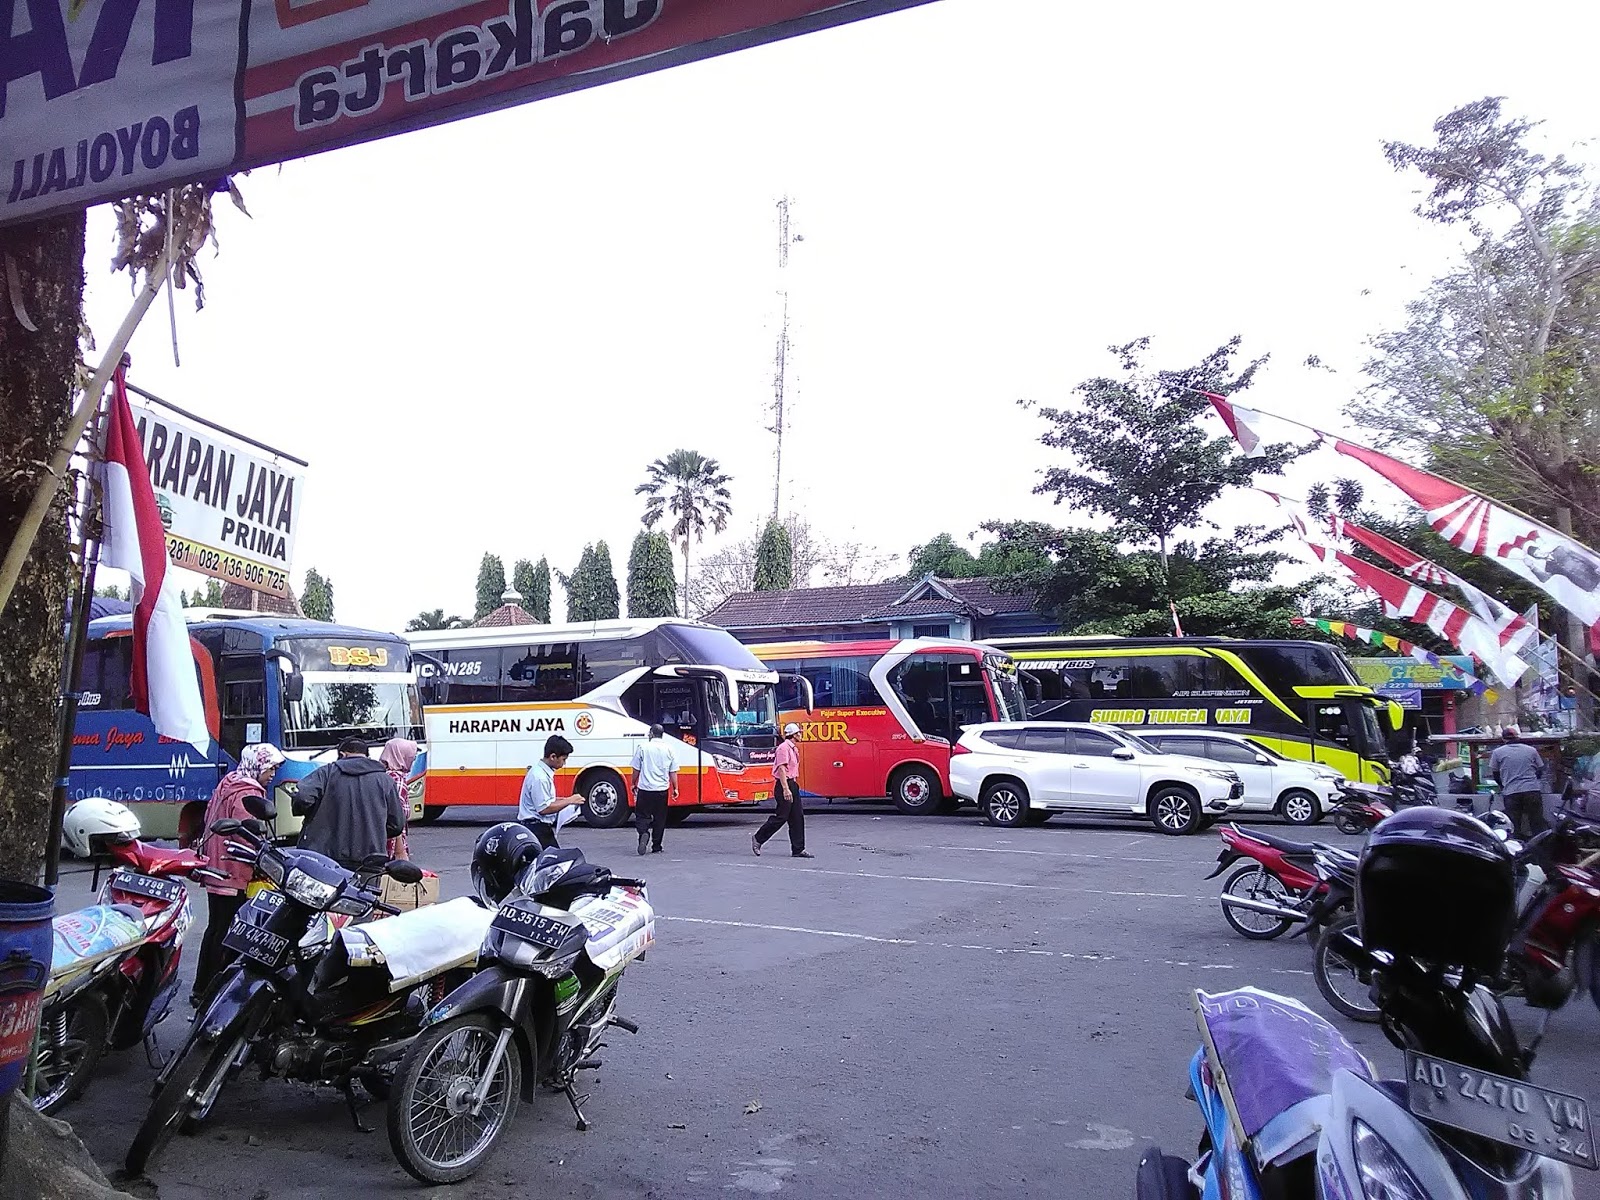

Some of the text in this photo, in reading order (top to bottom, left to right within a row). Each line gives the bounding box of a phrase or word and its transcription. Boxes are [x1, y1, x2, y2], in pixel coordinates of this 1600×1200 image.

[137, 416, 296, 534] ARAPAN JAYA
[221, 517, 287, 562] PRIMA
[169, 539, 191, 562] 281
[198, 549, 220, 571] 082
[223, 556, 242, 578] 136
[245, 563, 264, 585] 906
[267, 570, 286, 591] 725
[328, 646, 388, 667] BSJ
[820, 710, 836, 719] Fajar
[1090, 709, 1146, 724] SUDIRO
[1148, 709, 1208, 724] TUNGGA
[450, 718, 565, 733] HARAPAN JAYA
[104, 726, 145, 753] Jaya
[118, 874, 132, 883] AD
[258, 892, 267, 901] B
[231, 920, 245, 936] AD
[499, 906, 516, 919] AD
[518, 911, 548, 929] 3515
[549, 922, 569, 936] FW
[1414, 1058, 1585, 1132] AD 2470 YW
